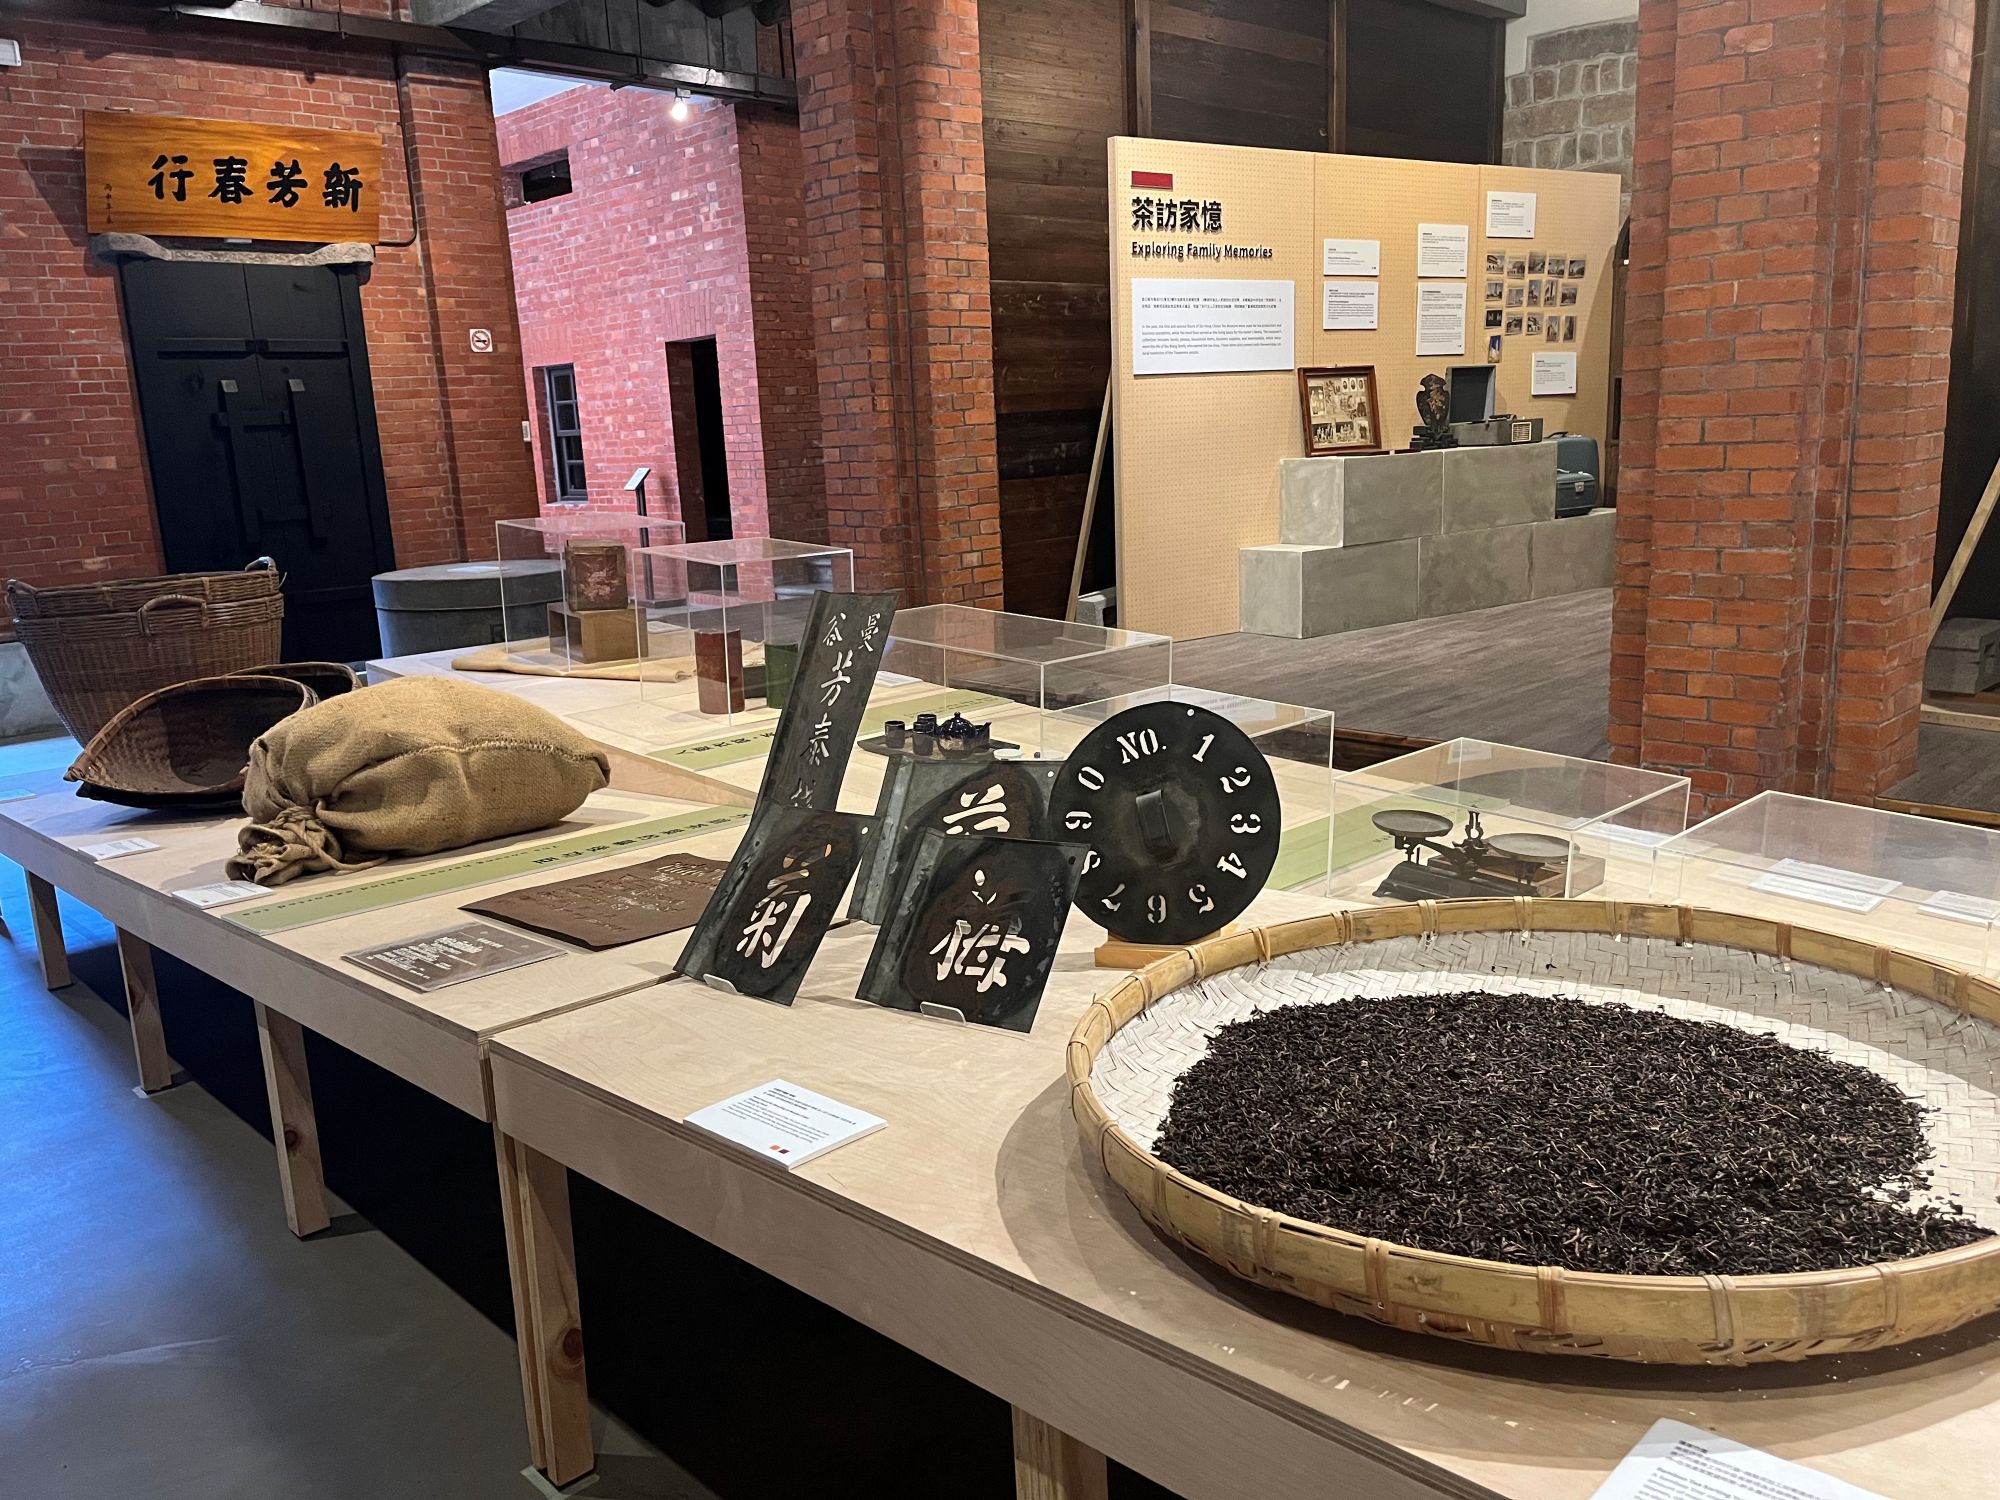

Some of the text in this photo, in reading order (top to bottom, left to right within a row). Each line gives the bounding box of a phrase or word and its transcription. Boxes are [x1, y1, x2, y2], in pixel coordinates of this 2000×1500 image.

[147, 154, 364, 213] 新芳春行
[1131, 196, 1223, 231] 茶訪家憶
[1132, 241, 1273, 260] Exploring Family Memories
[1116, 728, 1167, 764] NO.
[1192, 733, 1215, 763] 1
[1078, 766, 1105, 791] 0
[1220, 766, 1251, 794] 2
[1230, 813, 1262, 834] 3
[1216, 852, 1248, 879] 4
[1101, 883, 1126, 912] 7
[1188, 883, 1215, 914] 5
